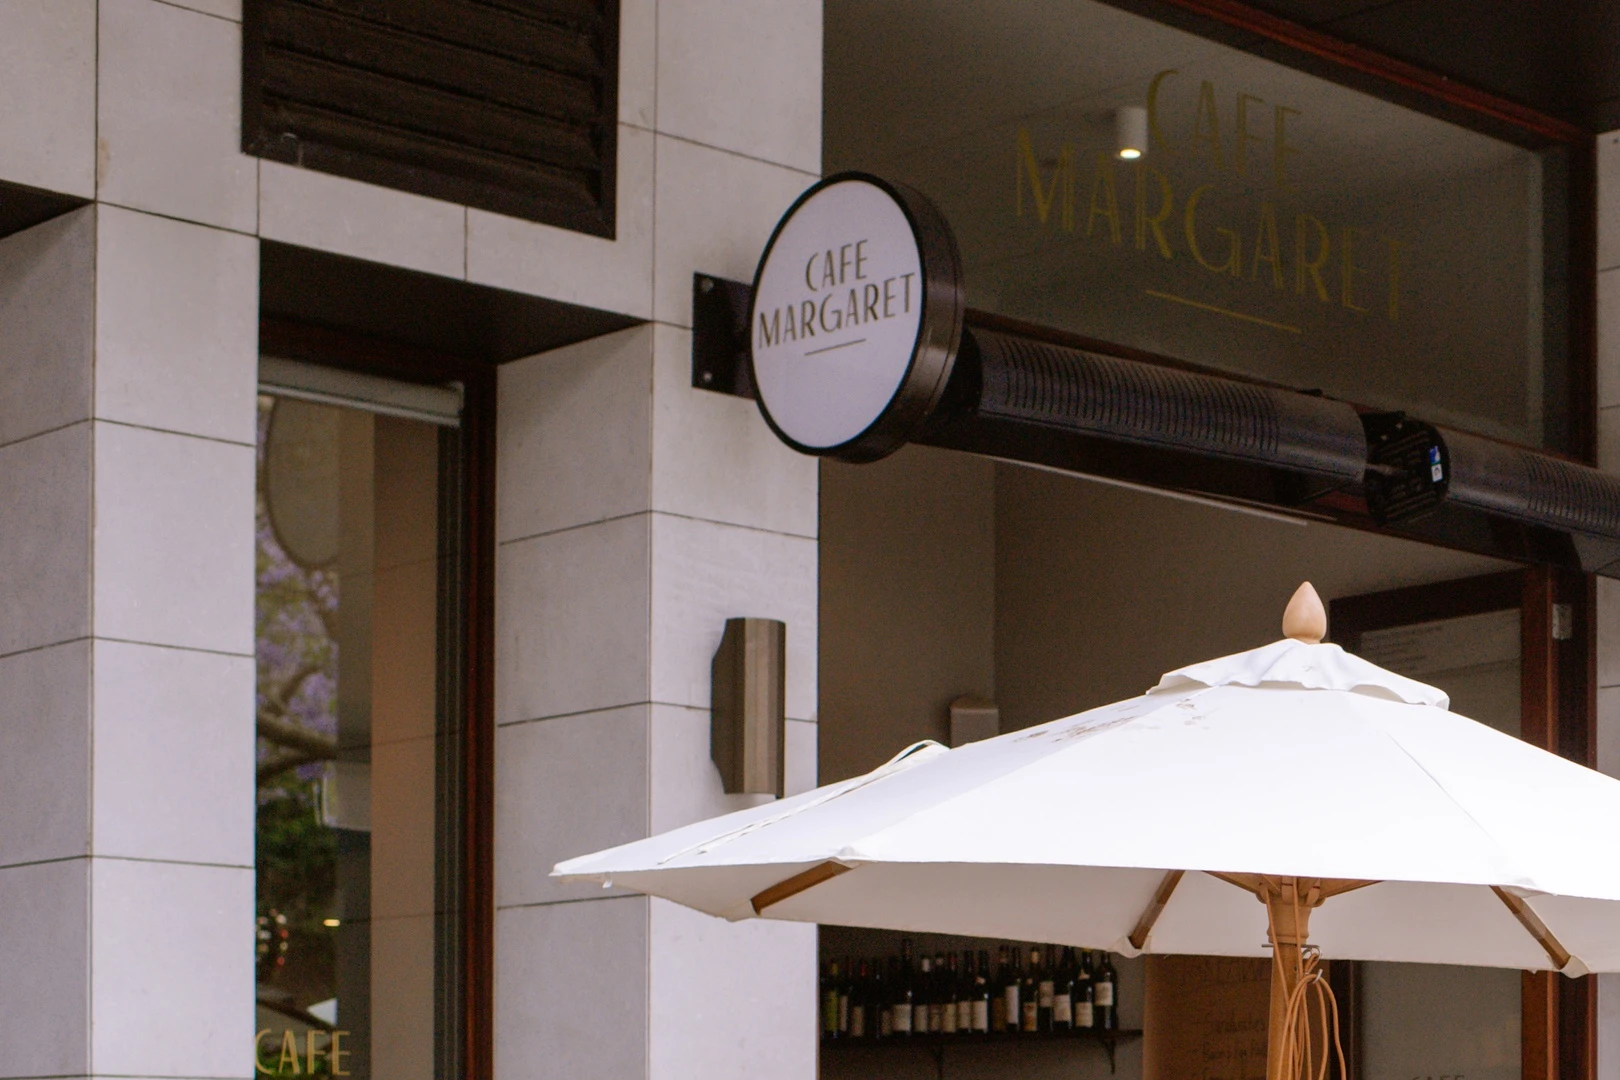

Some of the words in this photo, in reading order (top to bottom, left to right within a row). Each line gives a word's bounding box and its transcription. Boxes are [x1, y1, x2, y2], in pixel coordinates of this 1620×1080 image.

[1147, 69, 1301, 193] CAFE
[1017, 126, 1410, 321] MARGARET
[805, 239, 869, 292] CAFE
[758, 272, 916, 350] MARGARET
[255, 1028, 351, 1077] CAFE
